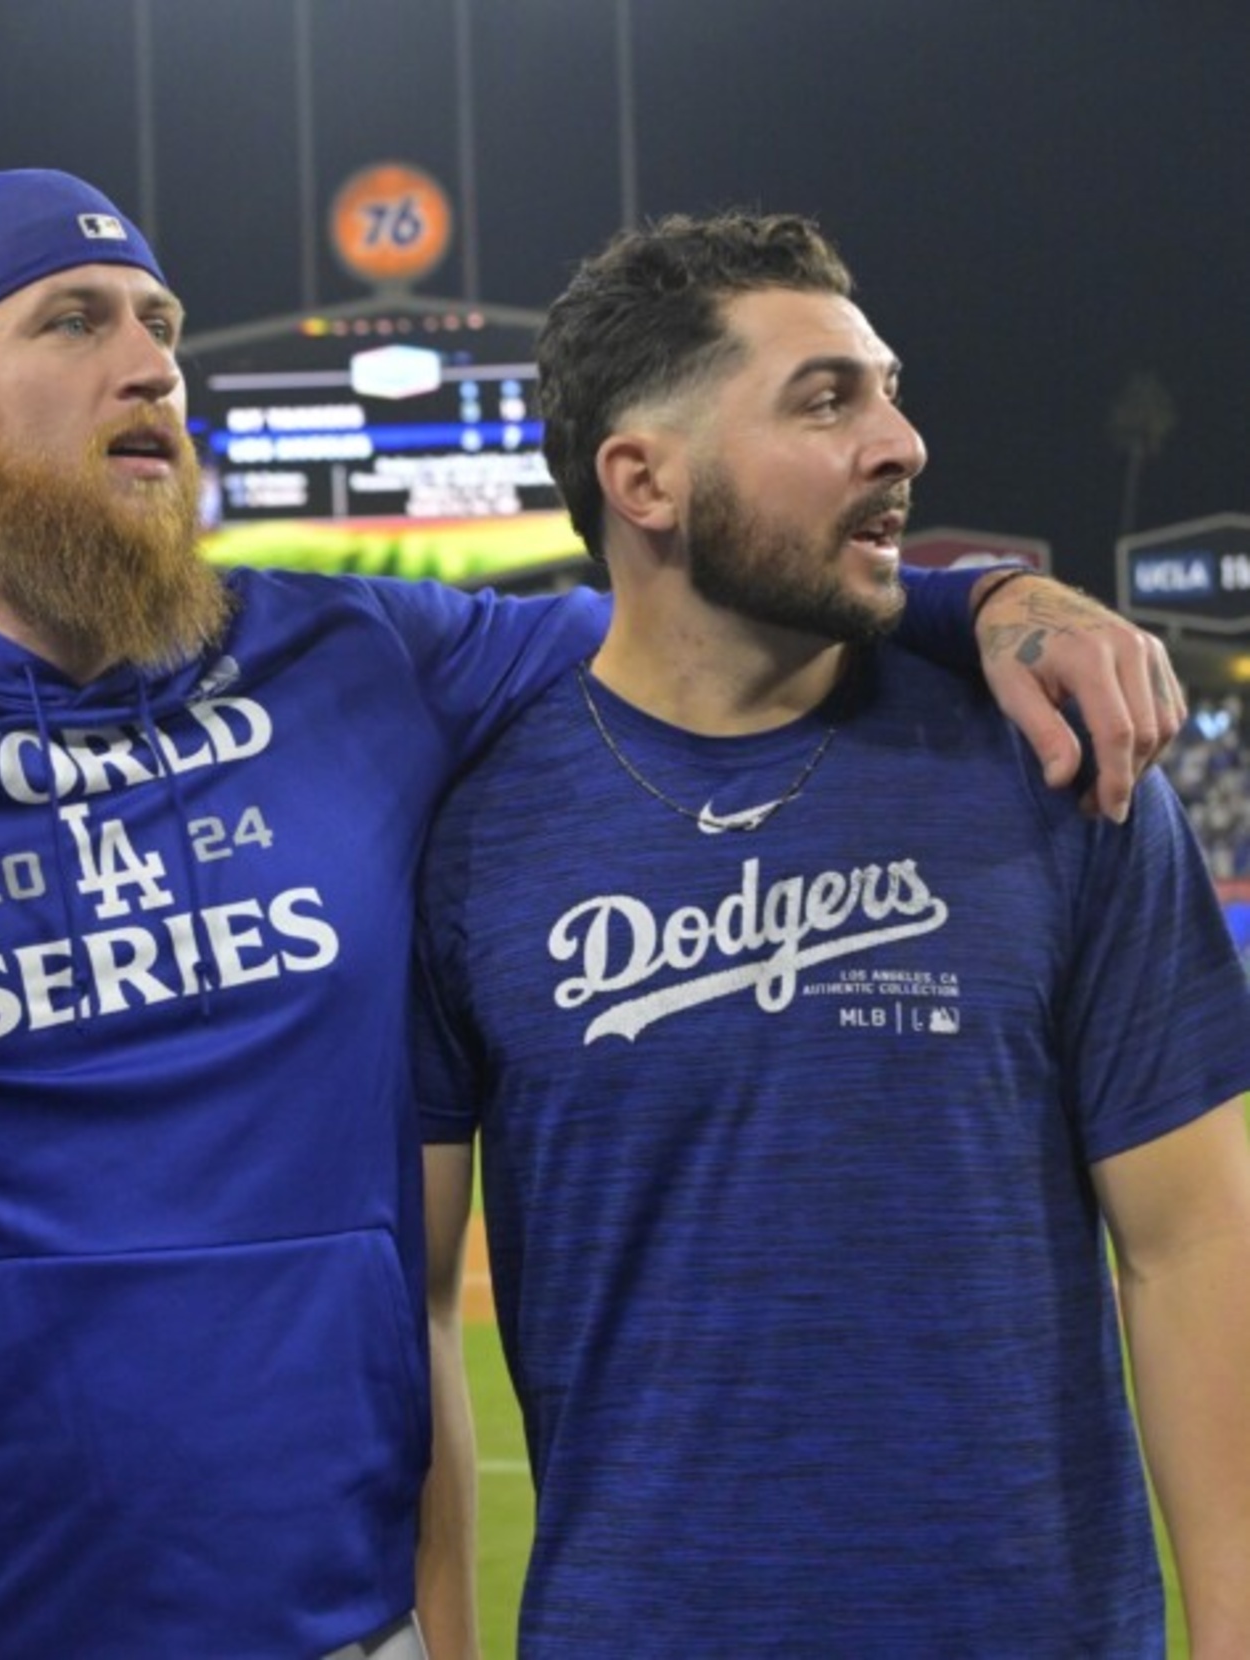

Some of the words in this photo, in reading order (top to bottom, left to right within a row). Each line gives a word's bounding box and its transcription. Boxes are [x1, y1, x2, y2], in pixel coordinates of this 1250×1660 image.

[359, 196, 422, 247] 76
[58, 802, 175, 920] LA
[187, 806, 274, 863] 24
[548, 857, 948, 1045] Dodgers
[802, 982, 874, 996] AUTHENTIC
[879, 983, 960, 997] COLLECTION
[840, 970, 867, 981] LOS
[940, 973, 958, 984] CA
[840, 1008, 886, 1027] MLB
